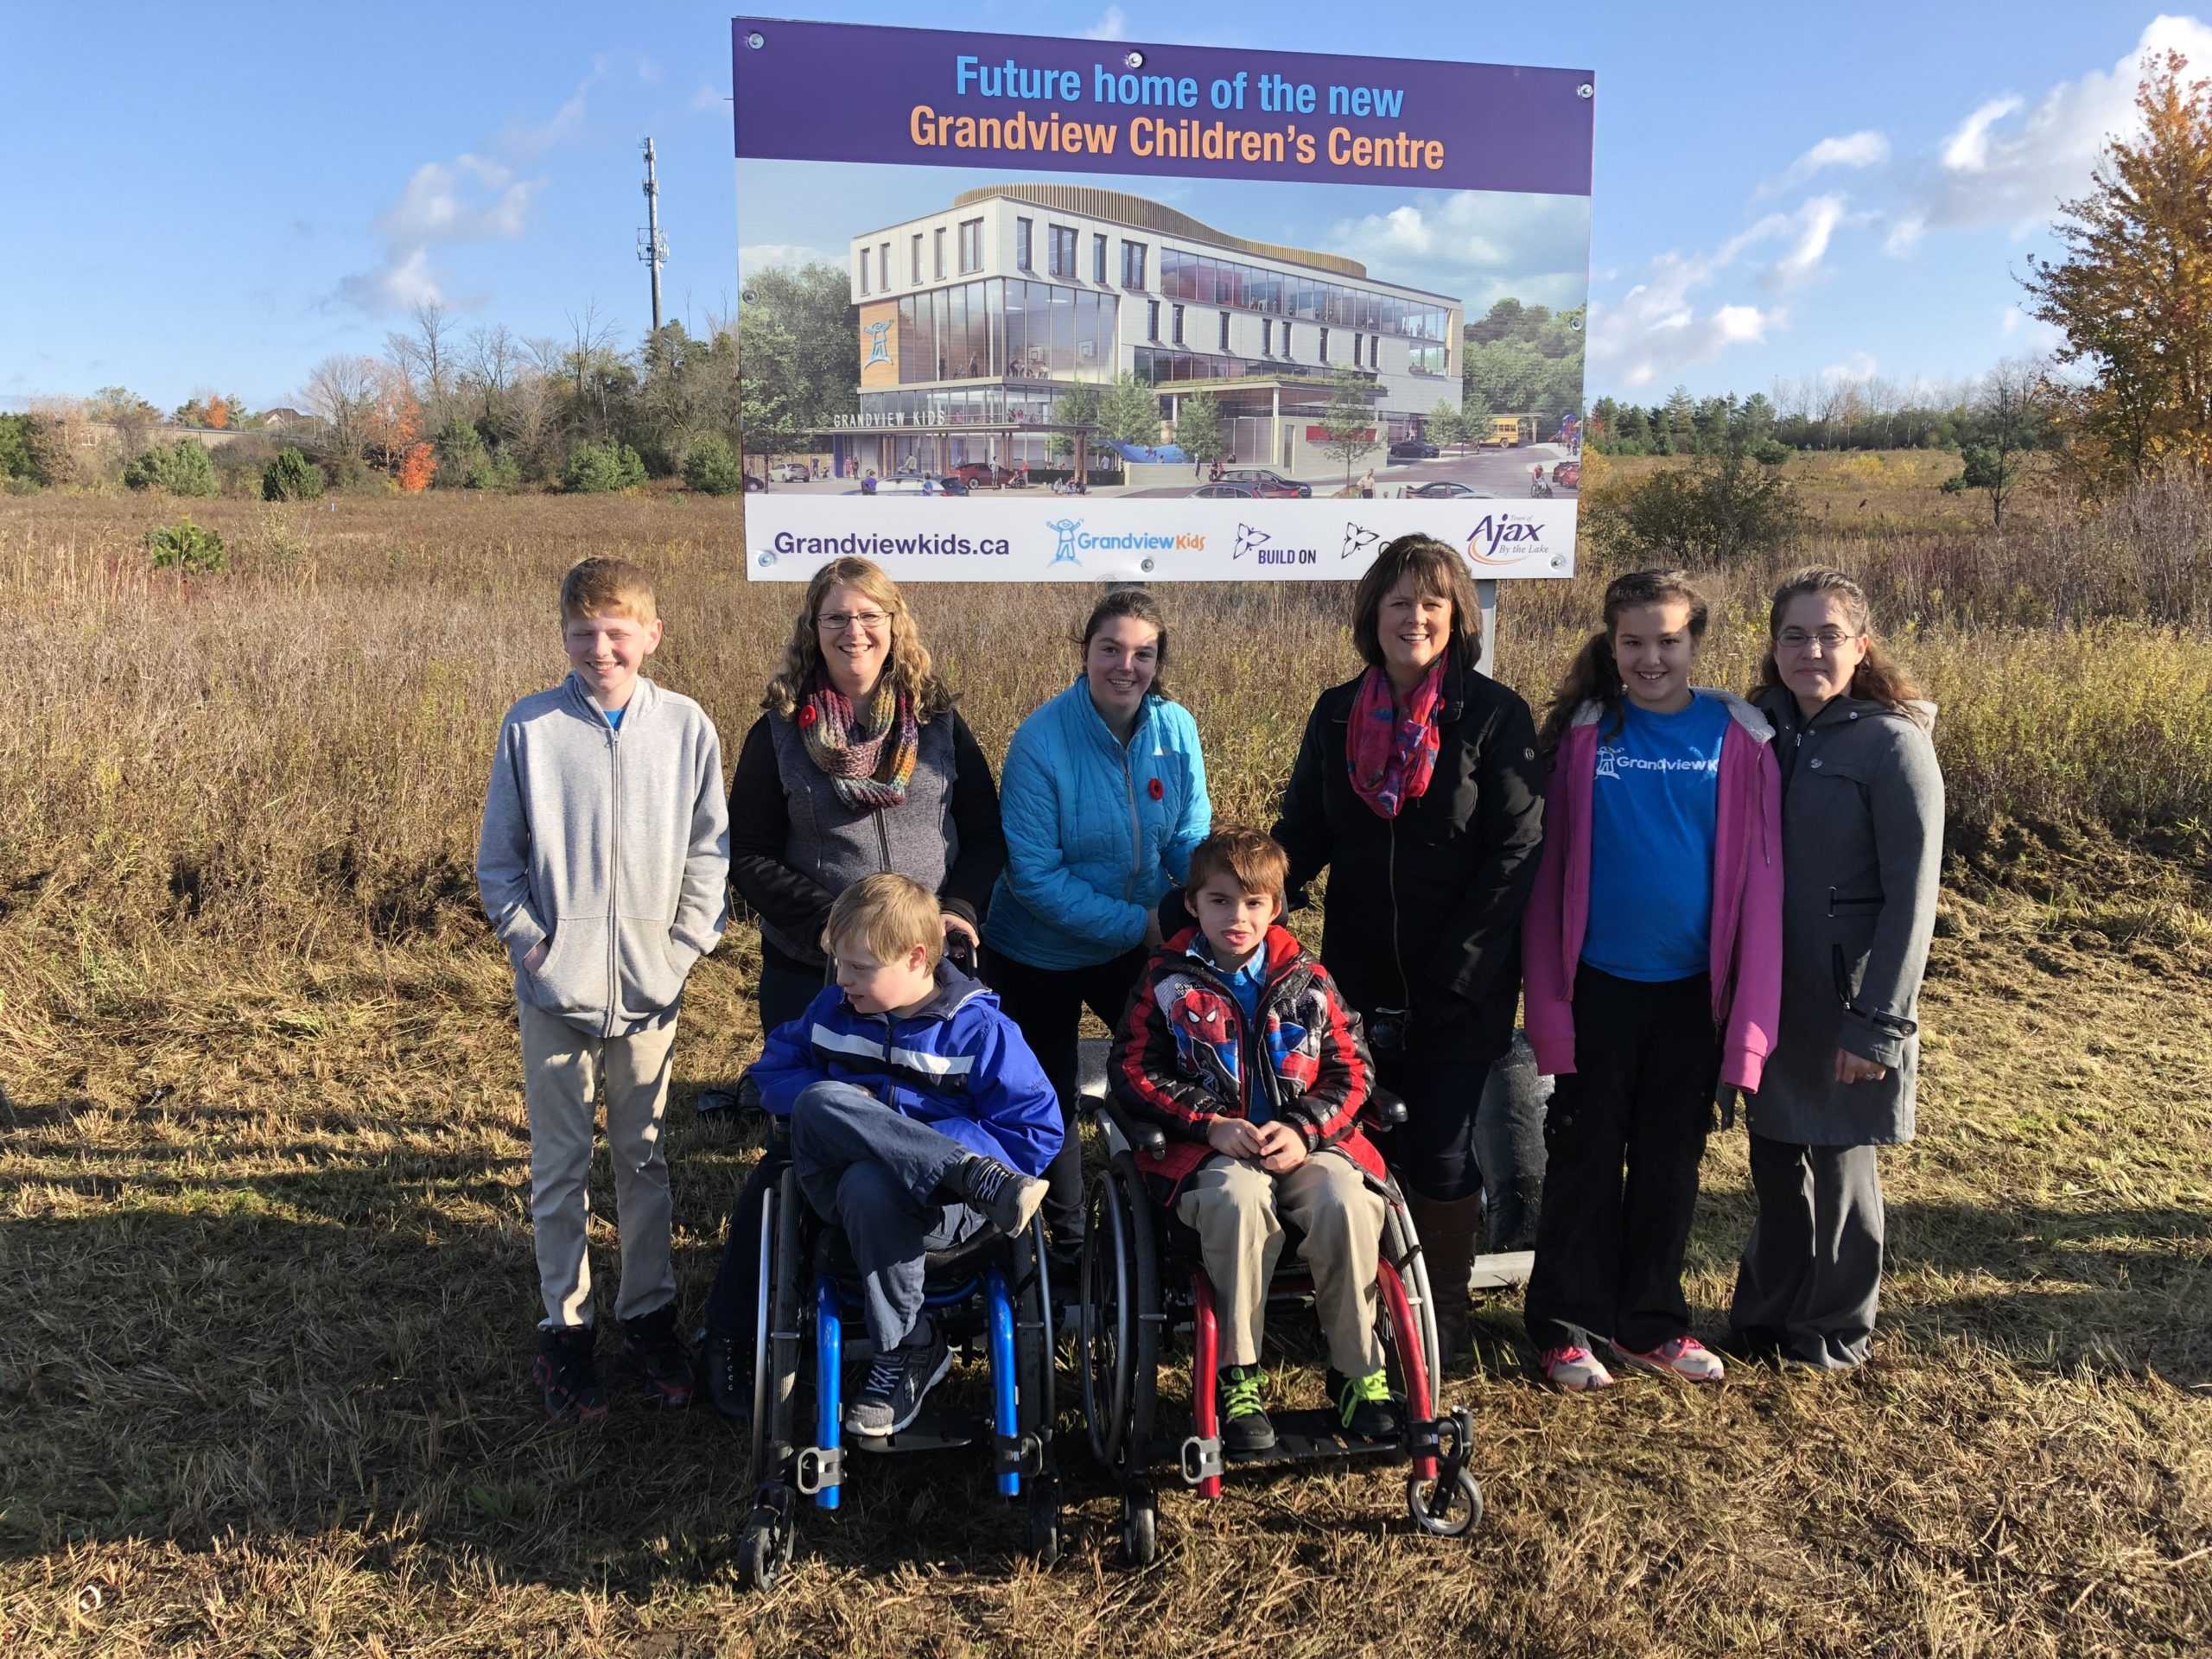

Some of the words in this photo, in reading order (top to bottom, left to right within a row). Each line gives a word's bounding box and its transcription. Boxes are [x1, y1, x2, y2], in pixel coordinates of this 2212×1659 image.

[957, 55, 1081, 102] Future
[1094, 63, 1198, 108] home
[1211, 72, 1248, 111] of
[1257, 73, 1316, 114] the
[1329, 86, 1404, 118] new
[910, 105, 1117, 154] Grandview
[1130, 117, 1316, 164] Children's
[1328, 127, 1445, 170] Centre
[834, 411, 905, 428] GRANDVIEW
[912, 410, 945, 426] KIDS
[1525, 514, 1534, 523] of
[774, 531, 1010, 556] Grandviewkids.ca
[1466, 513, 1546, 556] Ajax
[1258, 550, 1295, 564] BUILD
[1299, 550, 1317, 564] ON
[1498, 544, 1510, 556] By
[1512, 544, 1527, 554] the
[1528, 544, 1549, 554] Lake
